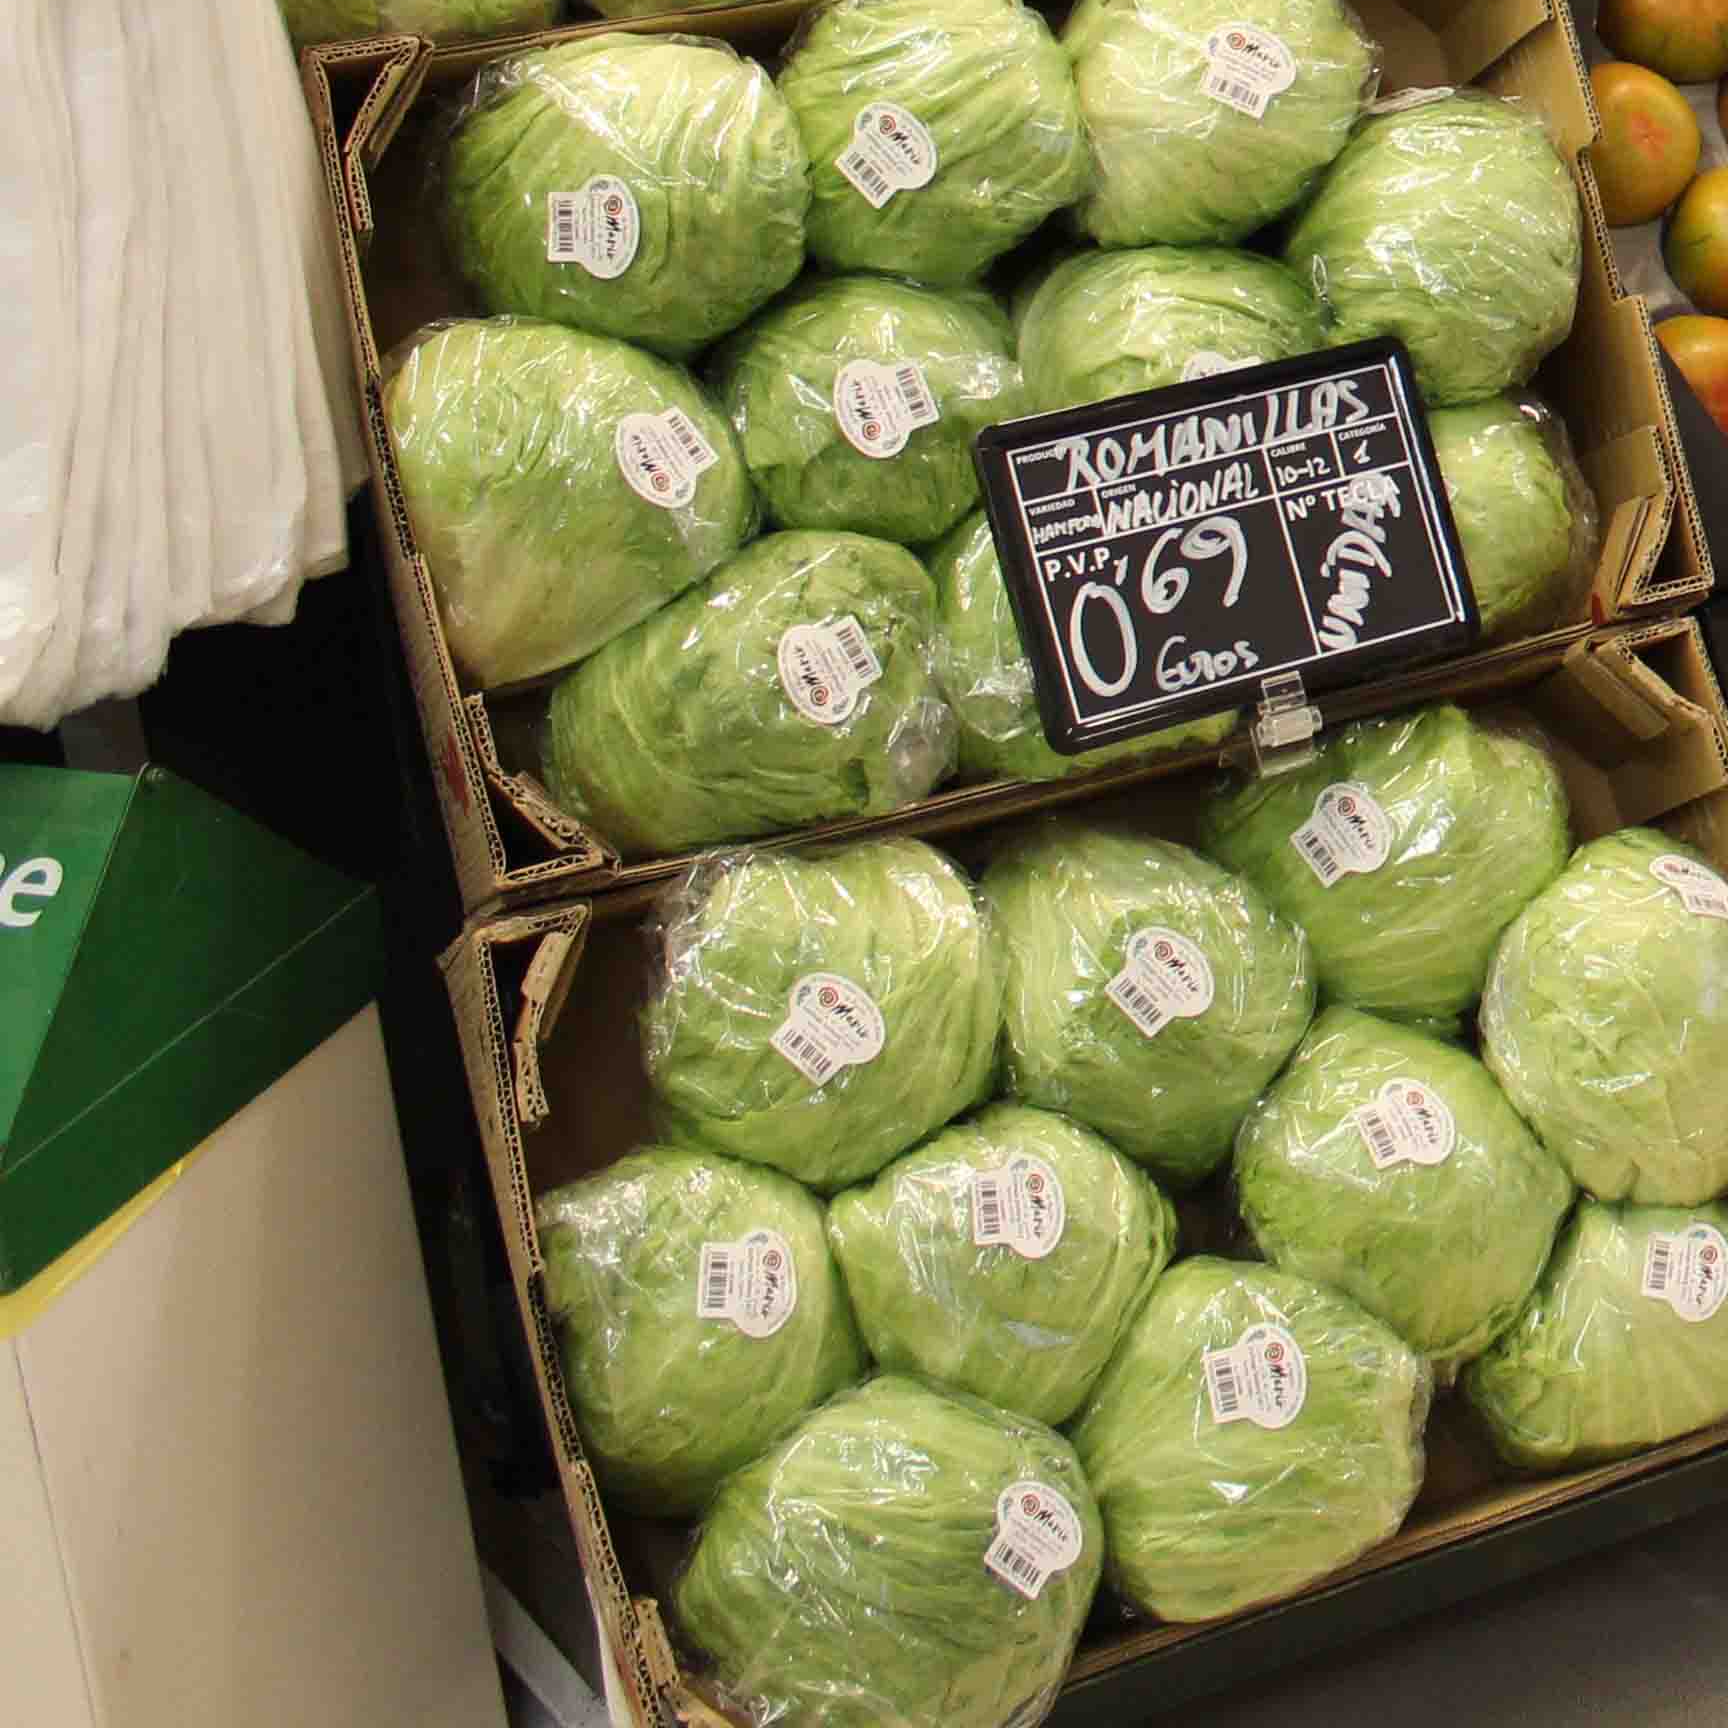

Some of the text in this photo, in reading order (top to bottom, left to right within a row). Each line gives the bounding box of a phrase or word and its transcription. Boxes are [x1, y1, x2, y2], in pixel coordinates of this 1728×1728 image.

[1054, 379, 1370, 493] ROMANILLAS
[1338, 423, 1387, 441] CATEGORÍA
[1271, 442, 1306, 457] CALIBRE
[1277, 457, 1332, 487] 10-12
[1102, 483, 1137, 499] ORIGEN
[1103, 462, 1259, 536] NACIONAL
[1029, 498, 1076, 516] VARIEDAD
[1044, 547, 1123, 583] P.V.P.
